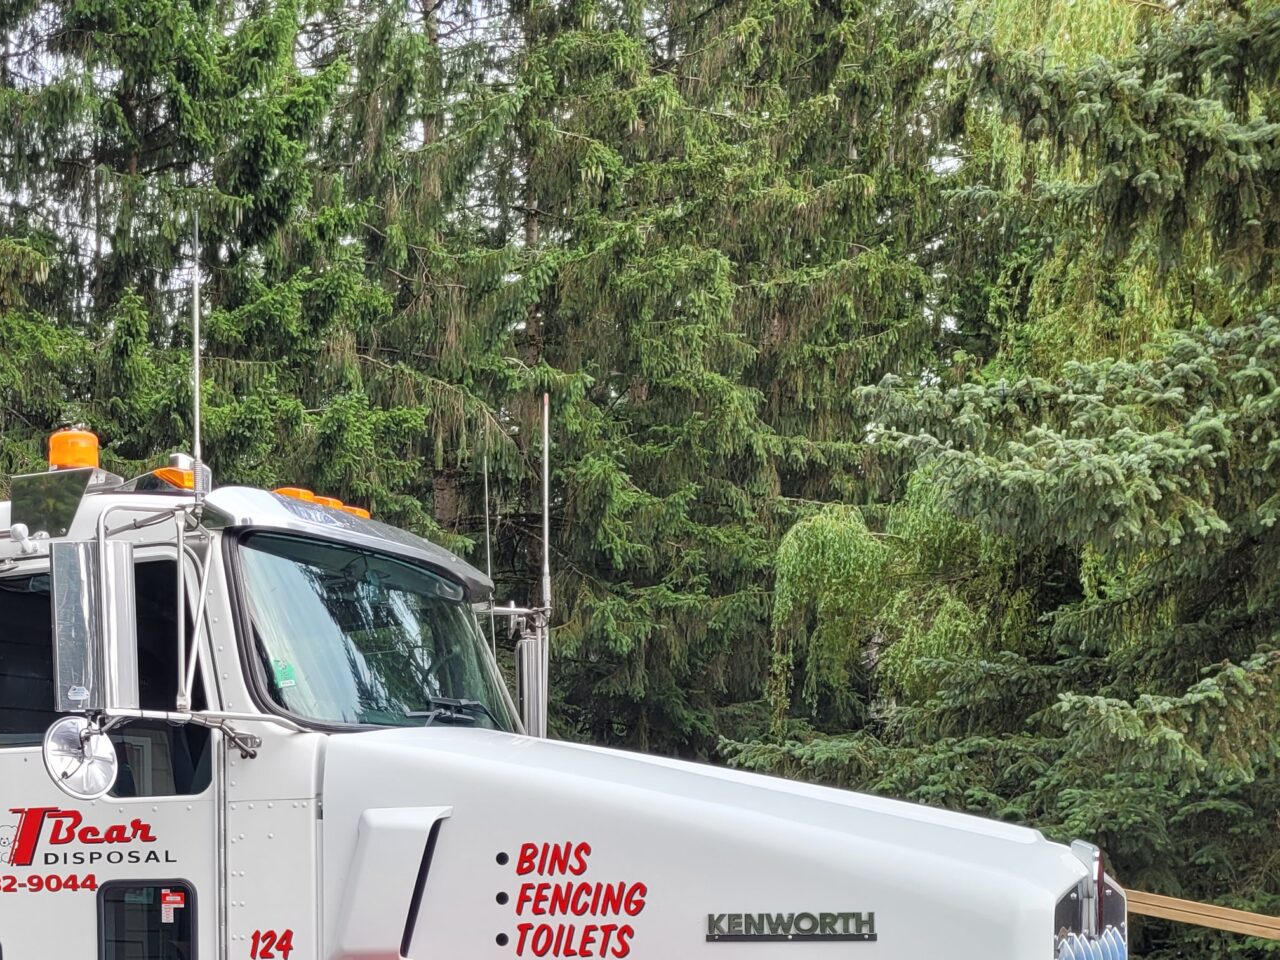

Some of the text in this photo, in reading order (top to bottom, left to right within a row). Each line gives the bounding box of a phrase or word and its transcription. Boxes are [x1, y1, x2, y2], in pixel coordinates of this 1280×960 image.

[43, 849, 178, 865] DISPOSAL
[516, 841, 592, 876] BINS
[516, 881, 648, 916] FENCING
[707, 911, 876, 935] KENWORTH
[250, 928, 294, 960] 124
[516, 922, 635, 959] TOILETS
